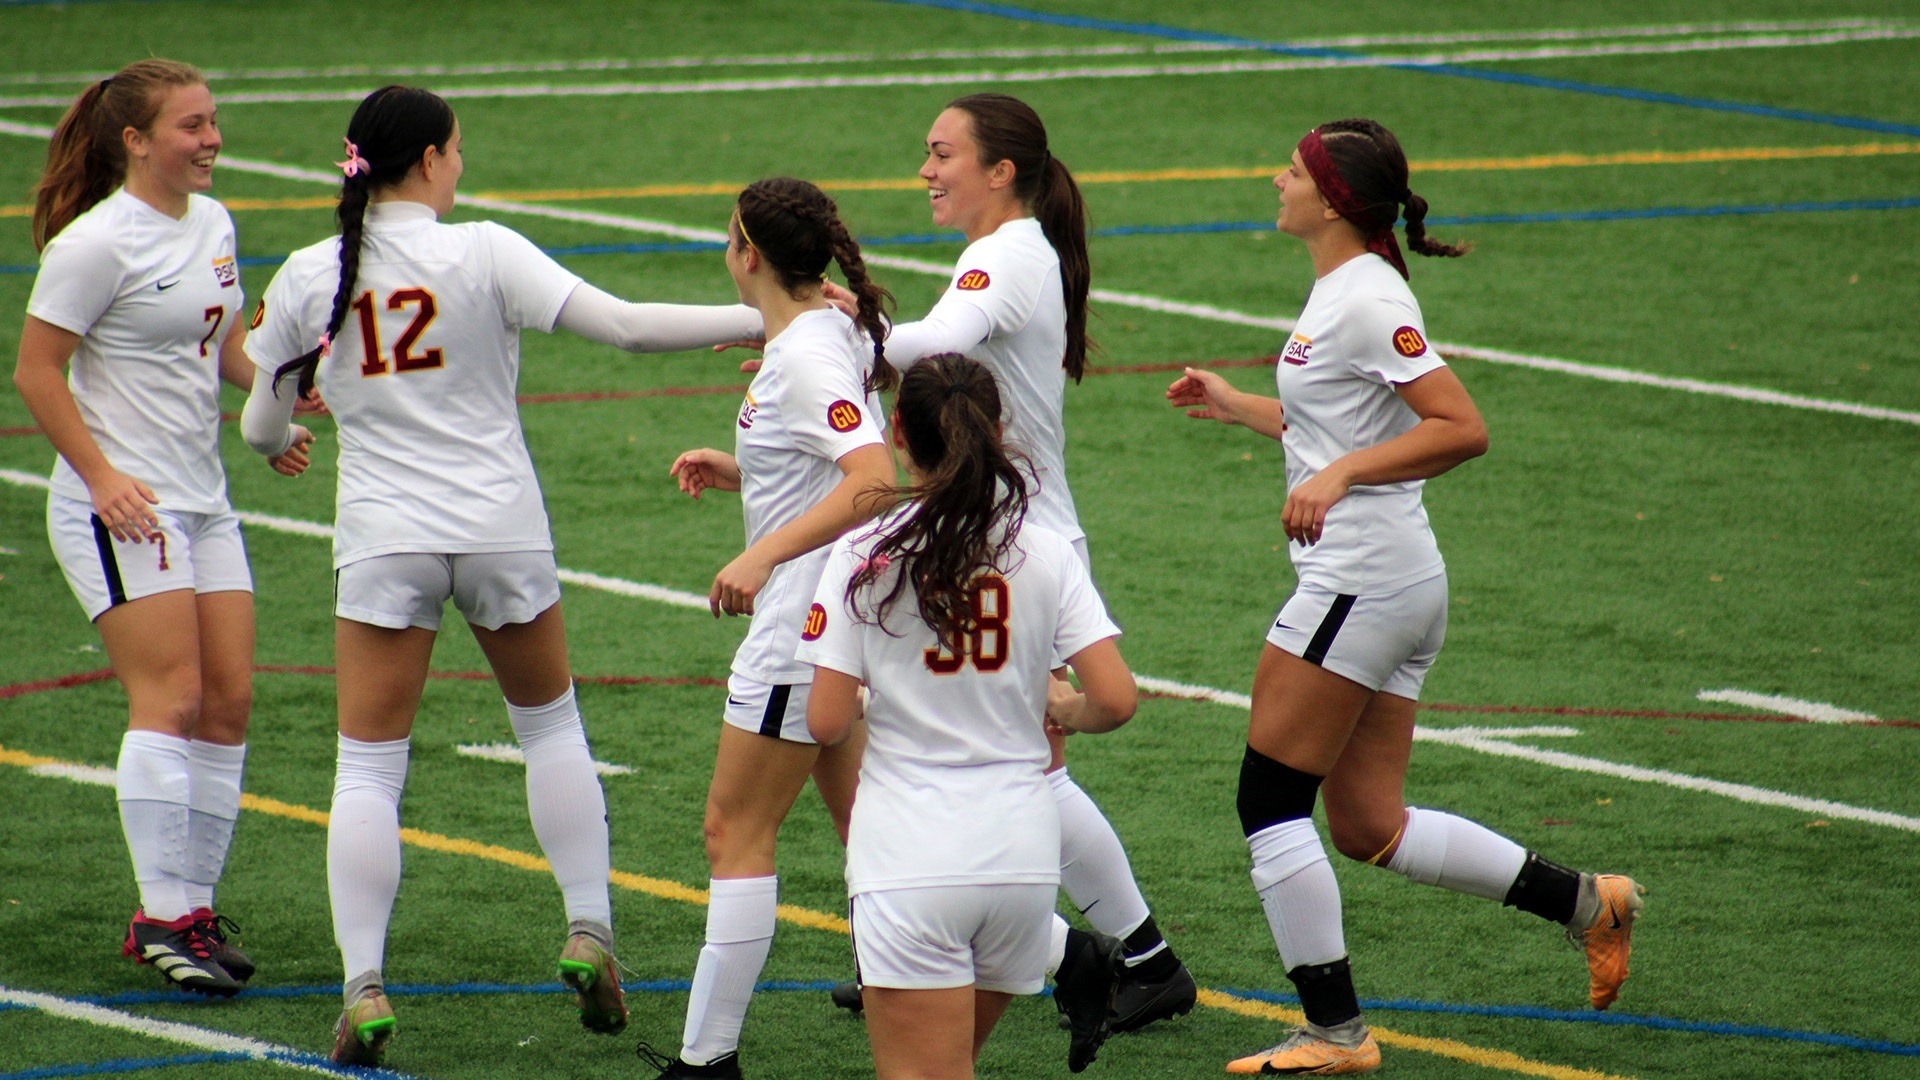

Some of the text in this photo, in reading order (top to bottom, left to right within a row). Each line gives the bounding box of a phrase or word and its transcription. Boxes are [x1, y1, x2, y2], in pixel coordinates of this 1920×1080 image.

[199, 305, 225, 357] 7
[352, 287, 444, 378] 12
[1397, 330, 1424, 355] GU
[831, 404, 858, 429] GU
[149, 530, 170, 572] 7
